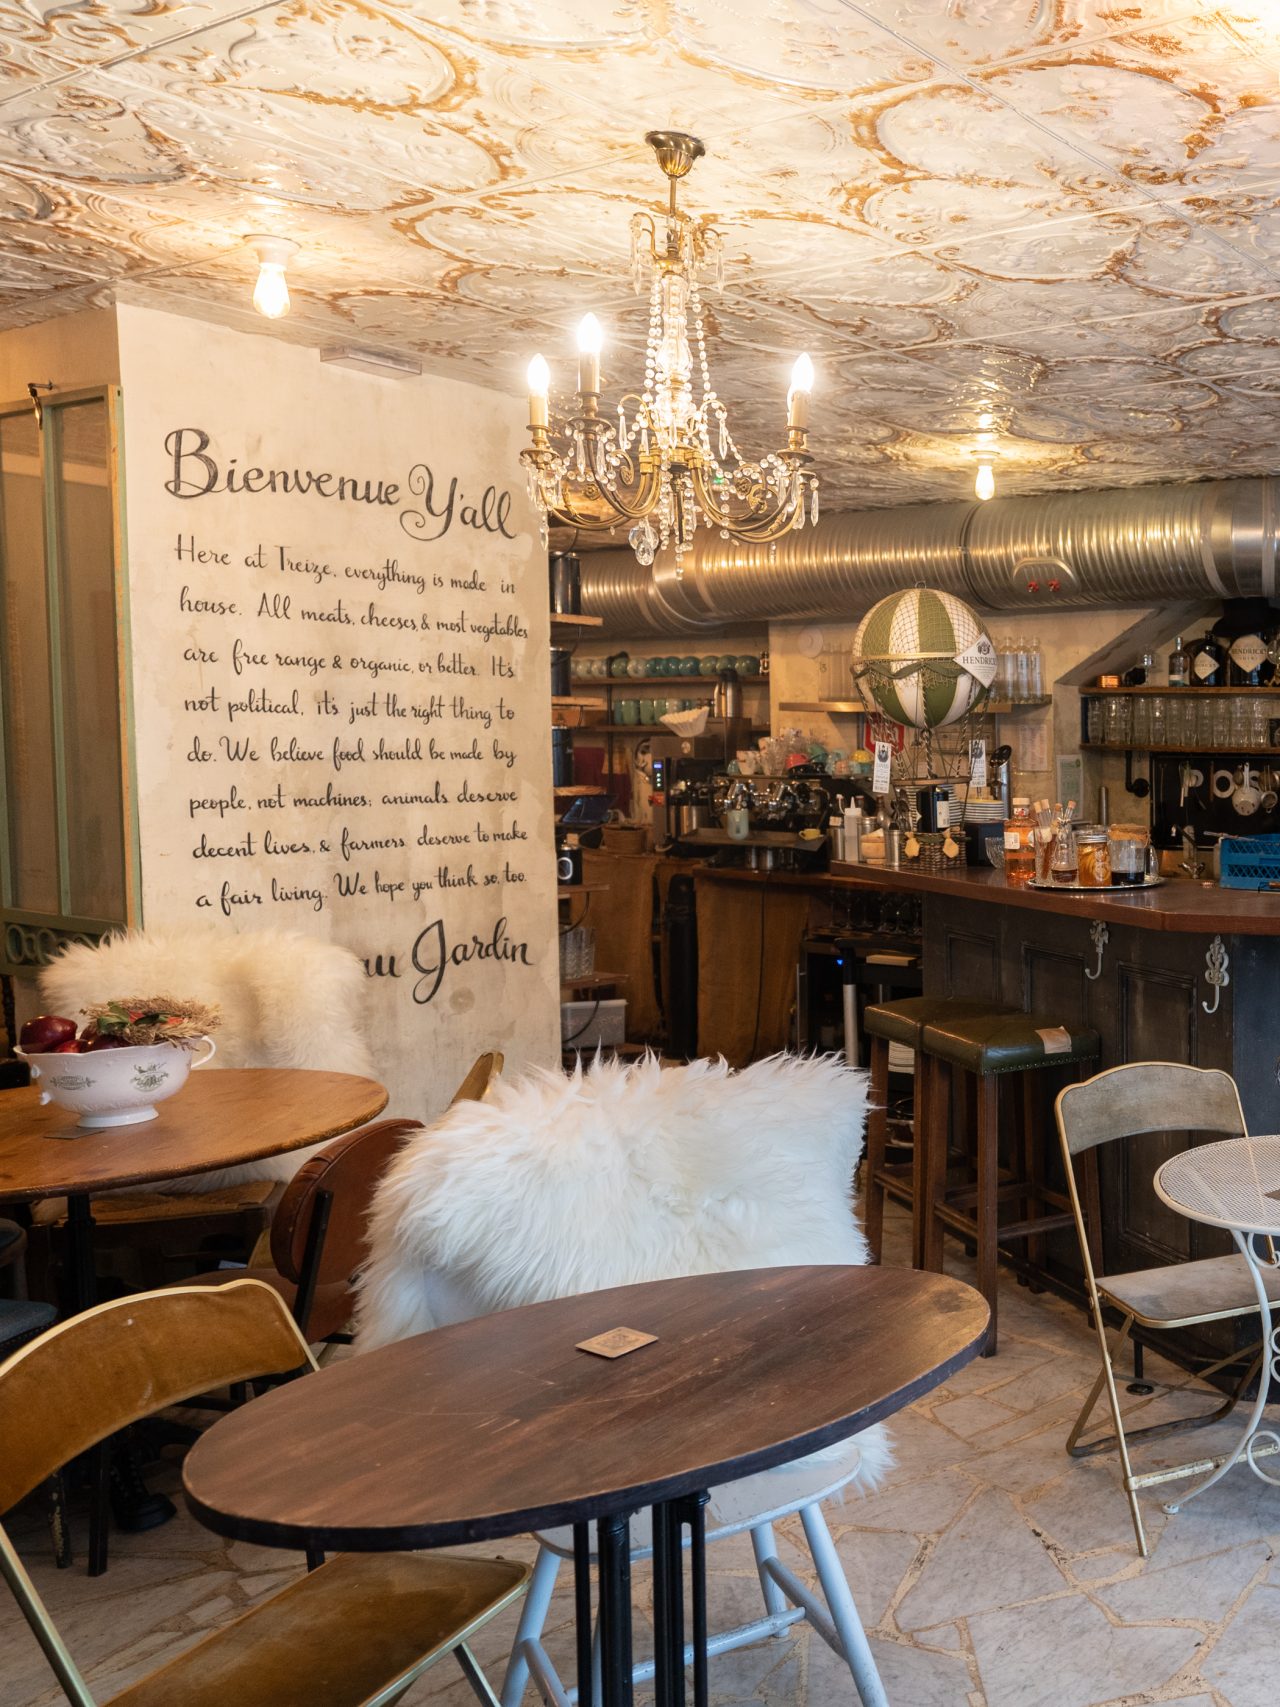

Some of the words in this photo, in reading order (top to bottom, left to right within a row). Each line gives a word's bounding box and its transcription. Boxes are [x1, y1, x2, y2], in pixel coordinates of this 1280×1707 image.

[164, 428, 400, 506] Bienvenue
[400, 464, 517, 541] Y'all
[174, 534, 231, 565] Here
[245, 544, 267, 568] at
[345, 559, 426, 594] everything
[433, 574, 443, 587] is
[451, 569, 487, 591] made
[501, 580, 515, 594] in
[180, 586, 242, 615] house.
[257, 592, 290, 620] All
[421, 613, 430, 630] &
[436, 610, 466, 633] most
[184, 648, 219, 663] are
[233, 639, 269, 675] free
[275, 653, 326, 676] range
[332, 655, 342, 669] &
[419, 662, 432, 674] or
[492, 656, 515, 678] It's
[184, 686, 221, 712] not
[317, 691, 339, 715] it's
[349, 692, 378, 725] just
[383, 693, 407, 717] the
[410, 695, 445, 725] right
[449, 696, 492, 729] thing
[496, 697, 514, 720] to
[187, 736, 216, 762] do.
[219, 736, 260, 761] We
[271, 736, 324, 762] believe
[333, 736, 366, 771] food
[372, 738, 423, 760] should
[429, 738, 445, 760] be
[450, 738, 484, 760] made
[493, 739, 517, 768] by
[257, 784, 286, 809] not
[382, 780, 450, 804] animals
[457, 780, 518, 803] deserve
[192, 832, 256, 859] decent
[320, 840, 331, 852] &
[340, 827, 406, 862] farmers
[417, 824, 470, 846] deserve
[474, 822, 489, 842] to
[493, 820, 528, 842] make
[195, 895, 213, 907] a
[220, 881, 263, 916] fair
[333, 872, 368, 897] We
[375, 870, 405, 902] hope
[412, 882, 433, 902] you
[434, 864, 478, 888] think
[503, 862, 527, 883] too.
[360, 954, 401, 978] u
[412, 917, 534, 1005] Jardin
